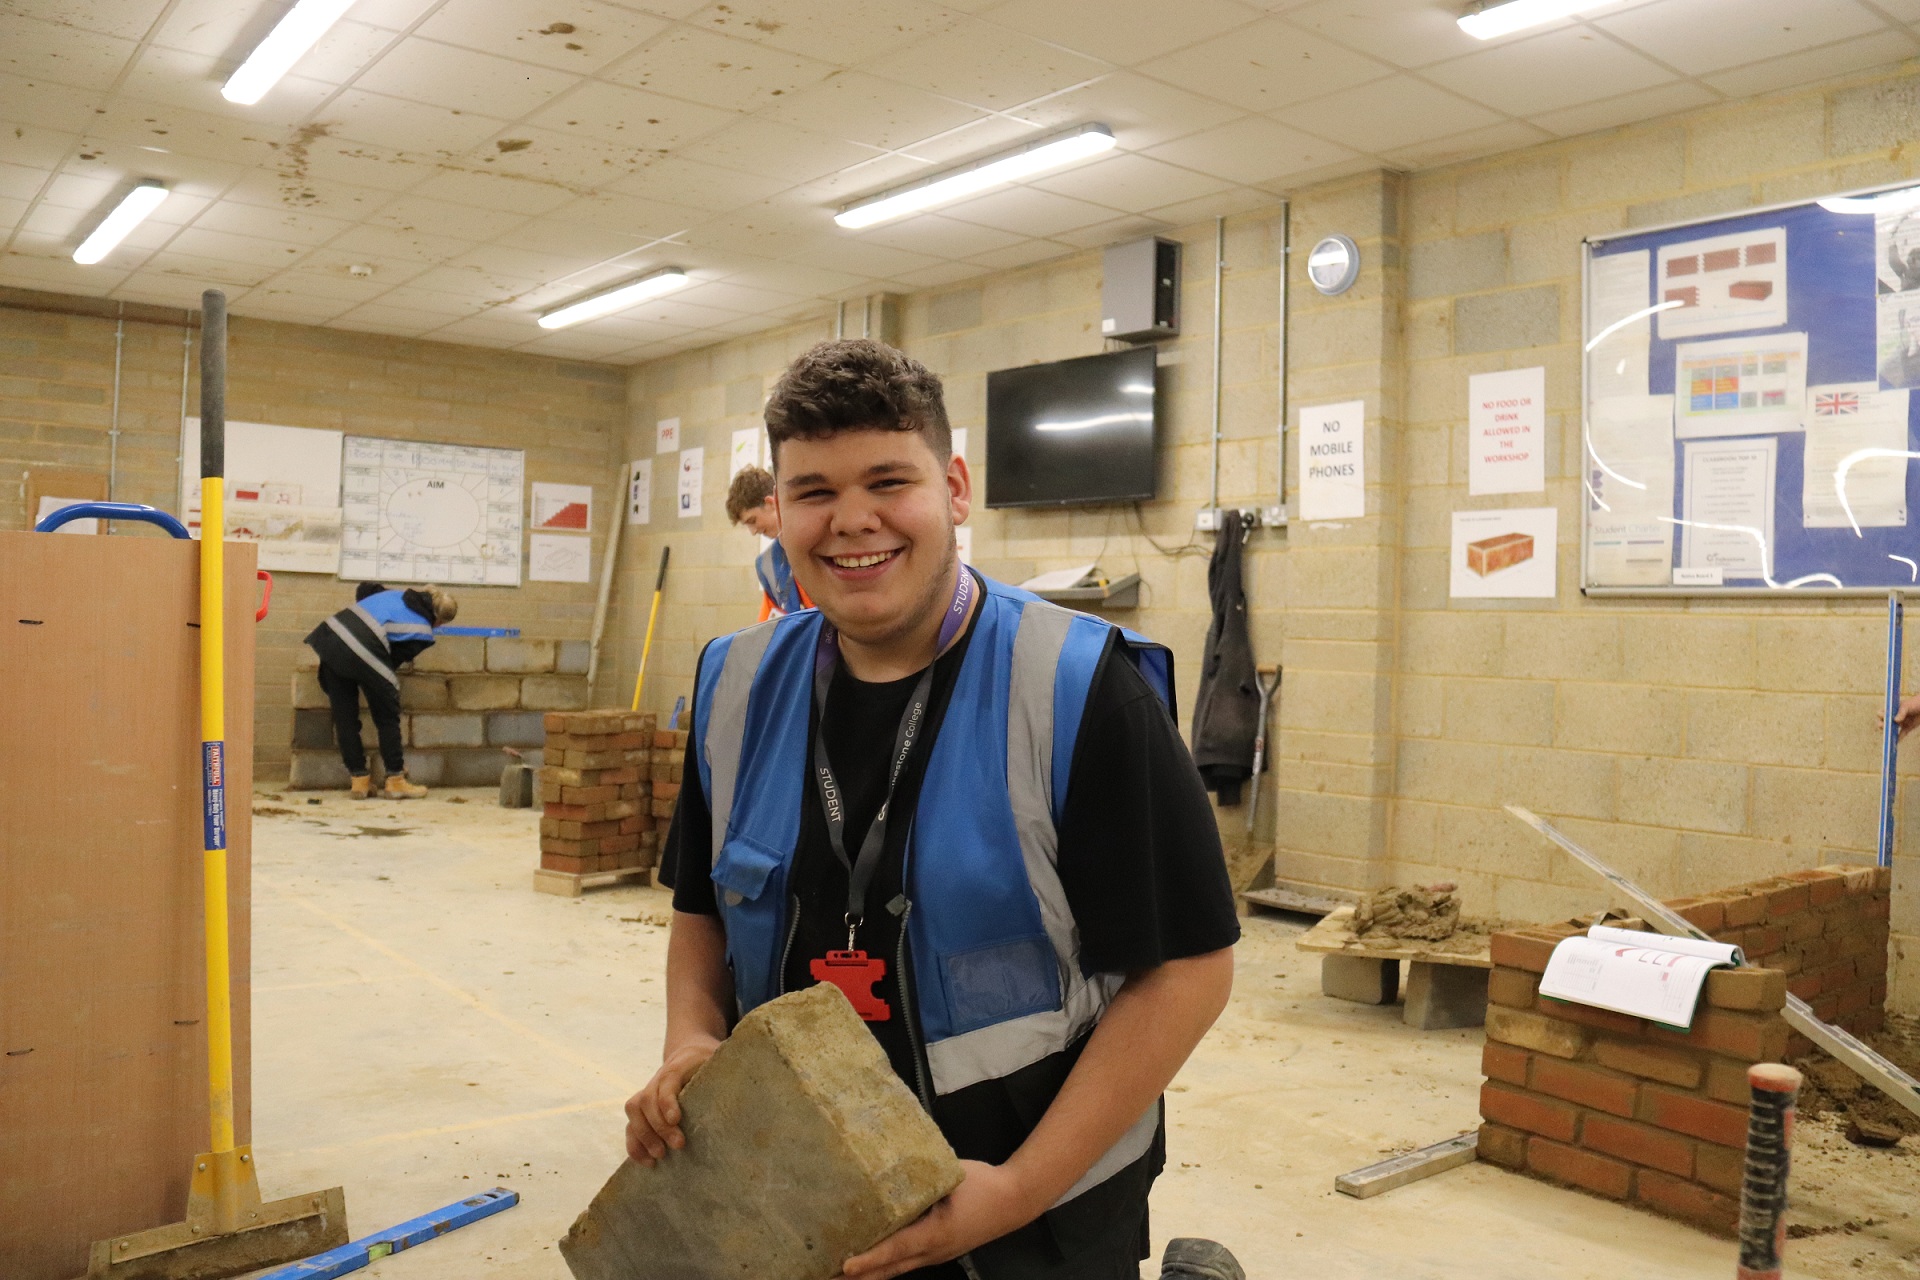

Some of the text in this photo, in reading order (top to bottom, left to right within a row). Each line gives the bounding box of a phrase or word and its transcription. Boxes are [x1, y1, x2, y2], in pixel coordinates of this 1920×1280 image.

[1482, 398, 1532, 410] NO FOOD OR
[1495, 412, 1519, 422] DRINK
[1322, 420, 1341, 434] NO
[1483, 425, 1531, 437] ALLOWED IN
[661, 427, 674, 440] PPE
[1310, 441, 1353, 457] MOBILE
[1500, 440, 1514, 449] THE
[1484, 452, 1530, 463] WORKSHOP
[1309, 464, 1354, 479] PHONES
[426, 480, 445, 489] AIM
[1594, 526, 1626, 535] Student
[953, 566, 970, 615] STUDENT
[905, 702, 922, 738] College
[819, 767, 841, 822] STUDENT
